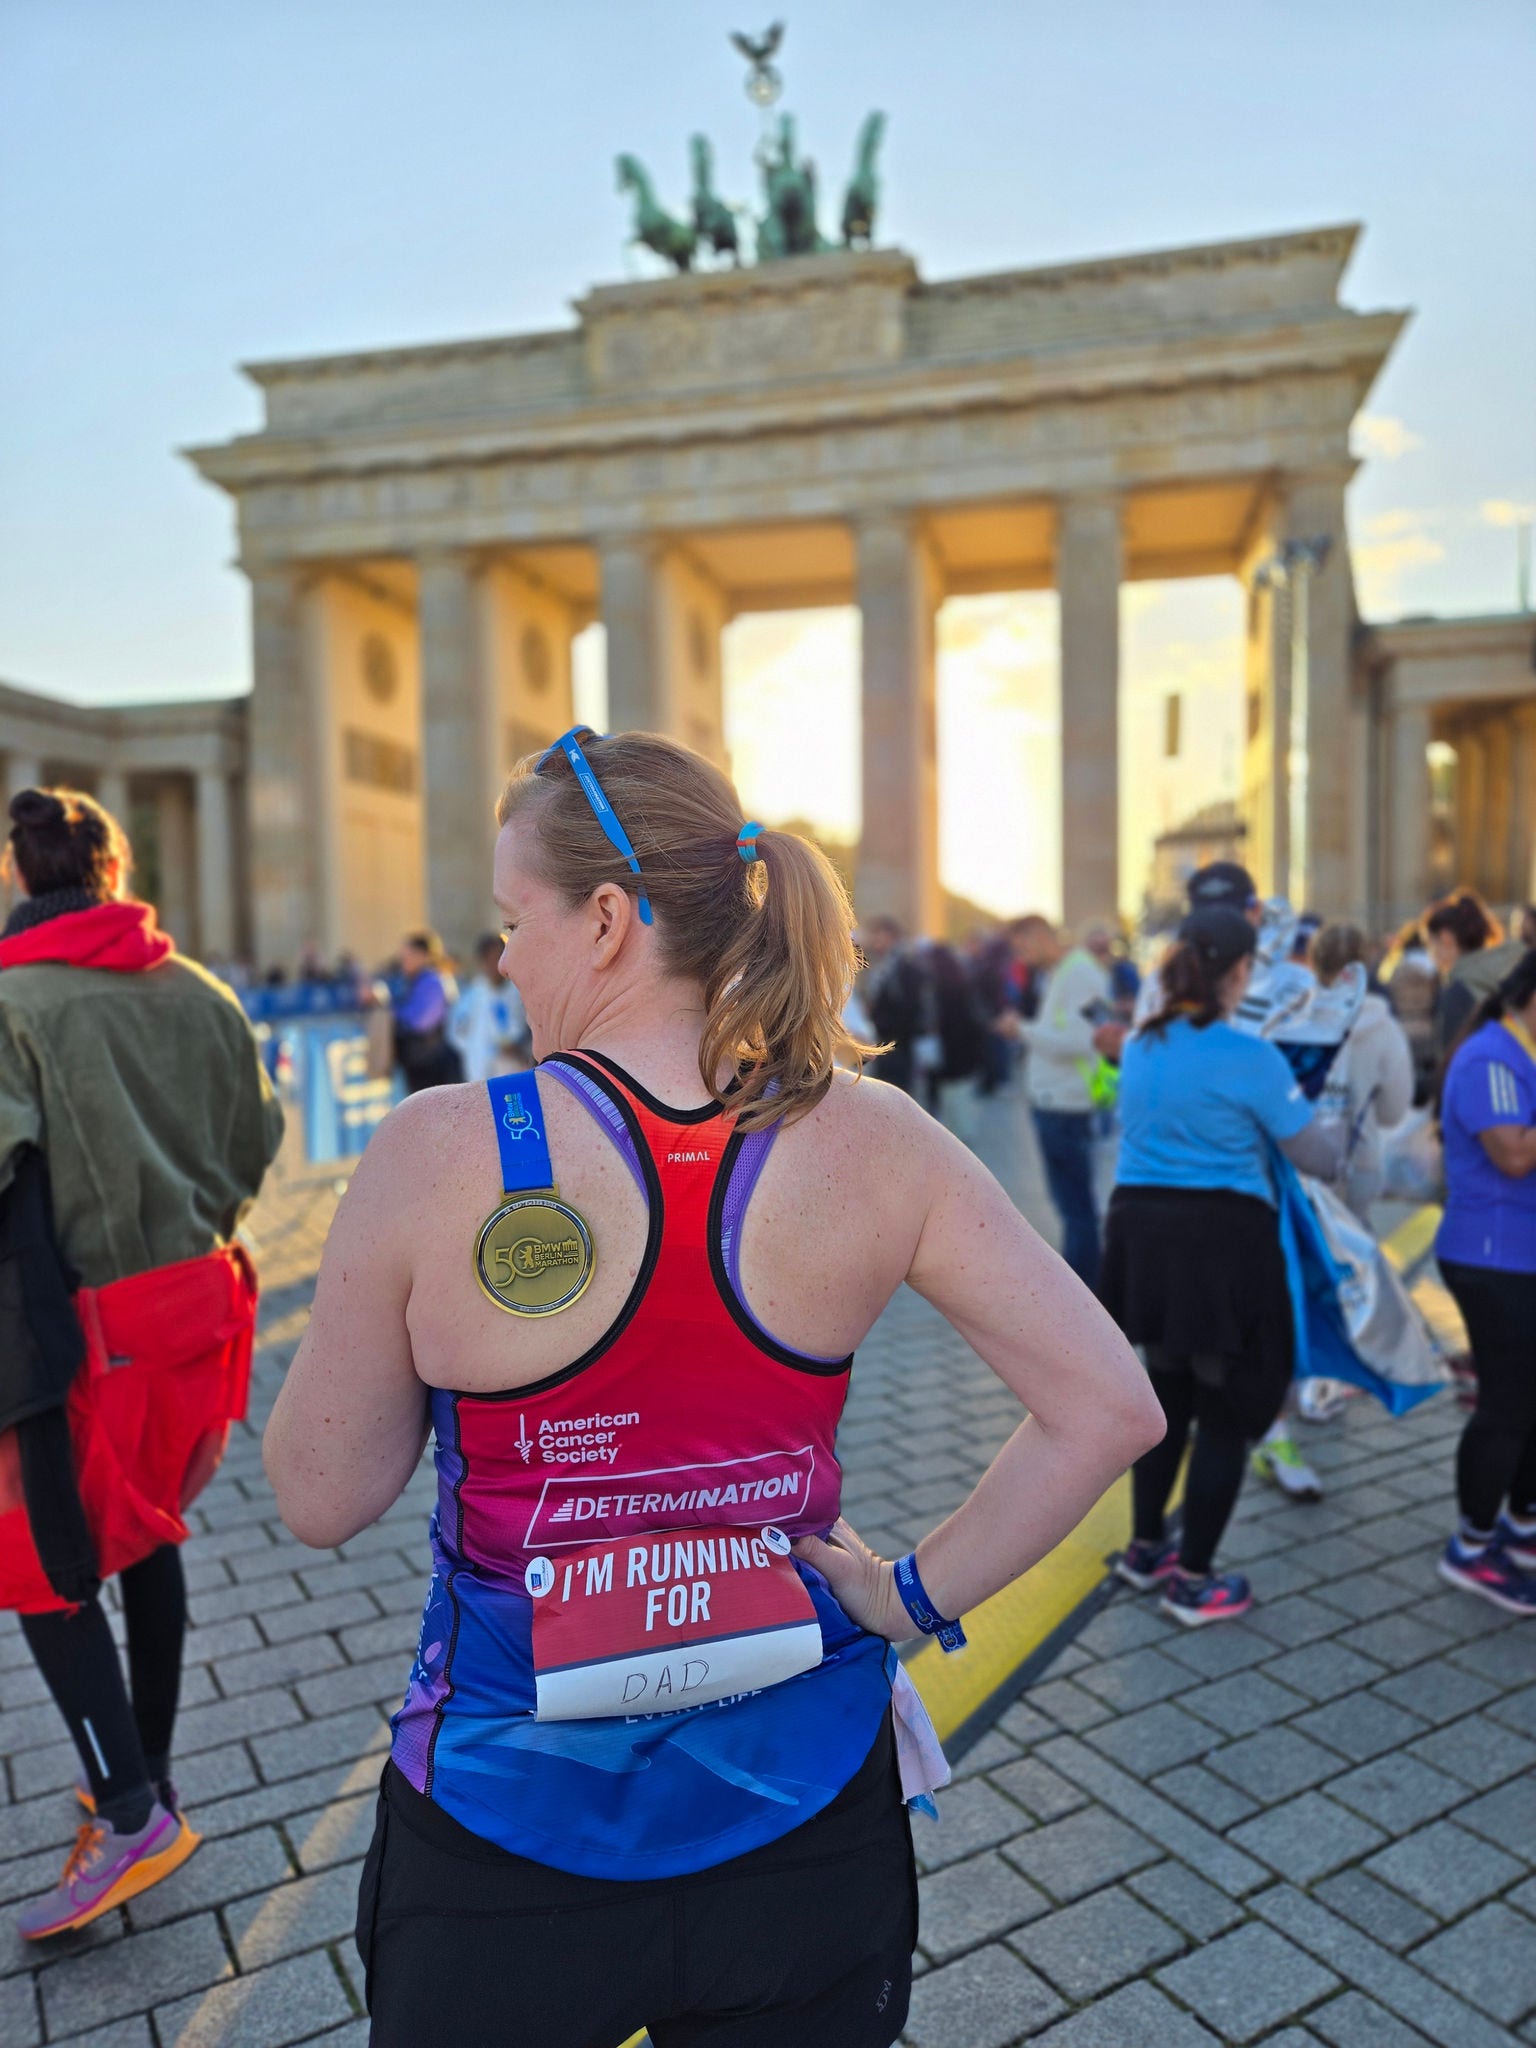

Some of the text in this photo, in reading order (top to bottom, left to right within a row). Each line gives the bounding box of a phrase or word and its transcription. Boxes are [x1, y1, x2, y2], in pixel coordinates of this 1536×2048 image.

[667, 1151, 711, 1163] PRIMAL
[534, 1242, 561, 1254] BMW
[534, 1251, 563, 1261] BERLIN
[495, 1237, 546, 1288] 50
[535, 1257, 579, 1268] MARATHON
[538, 1411, 640, 1435] American
[538, 1431, 617, 1449] Cancer
[542, 1445, 619, 1465] Society
[574, 1471, 800, 1522] DETERMINATION
[561, 1553, 615, 1603] I'M
[626, 1536, 771, 1589] RUNNING
[645, 1580, 712, 1632] FOR
[620, 1659, 710, 1705] DAD
